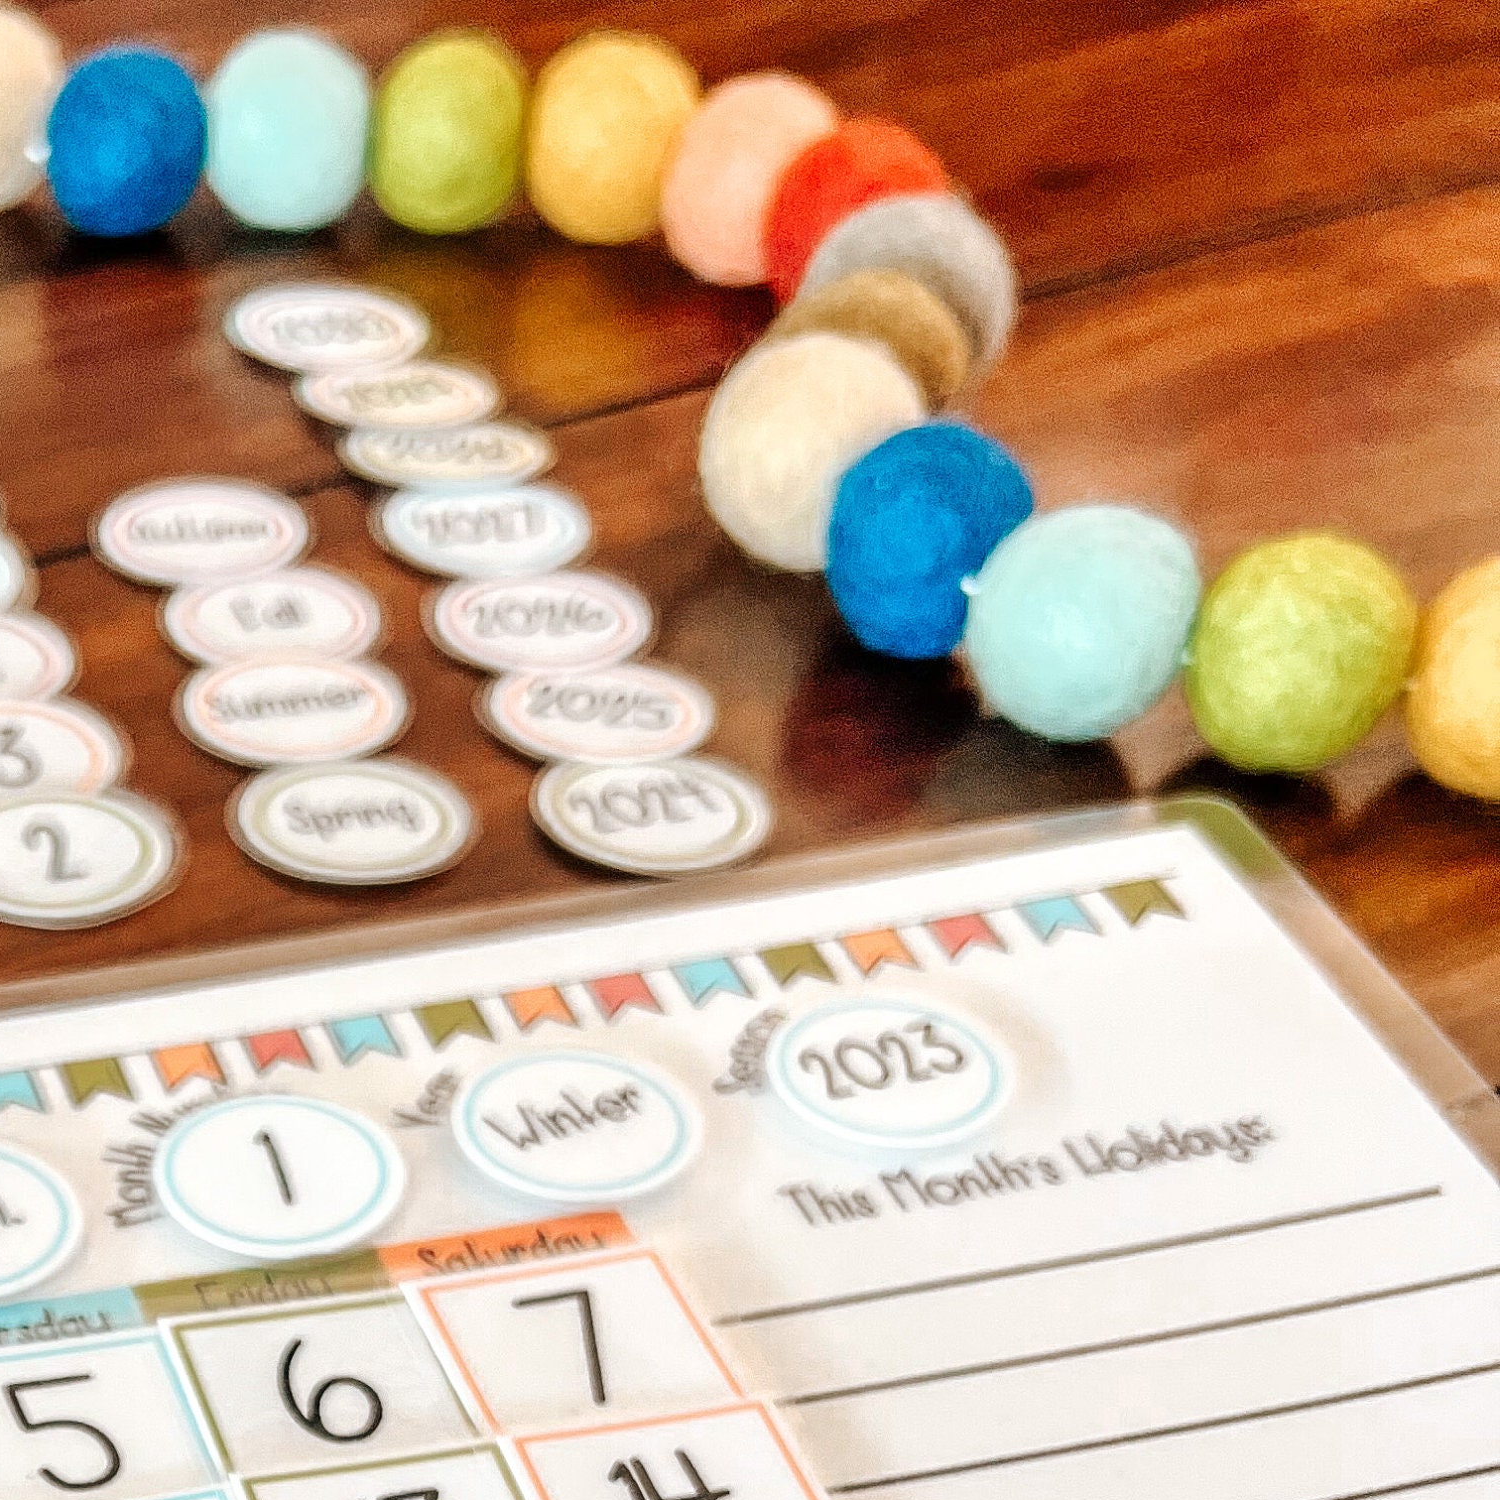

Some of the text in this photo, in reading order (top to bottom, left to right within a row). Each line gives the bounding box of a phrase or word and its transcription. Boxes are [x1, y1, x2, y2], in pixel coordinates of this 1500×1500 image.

[21, 812, 90, 884] 2
[283, 796, 425, 843] Spring
[797, 1018, 966, 1102] 2023
[482, 1083, 641, 1152] Winter
[253, 1127, 296, 1205] 1
[778, 1180, 882, 1226] This
[6, 1373, 123, 1492] 5
[280, 1338, 385, 1444] 6
[511, 1288, 606, 1407] 7
